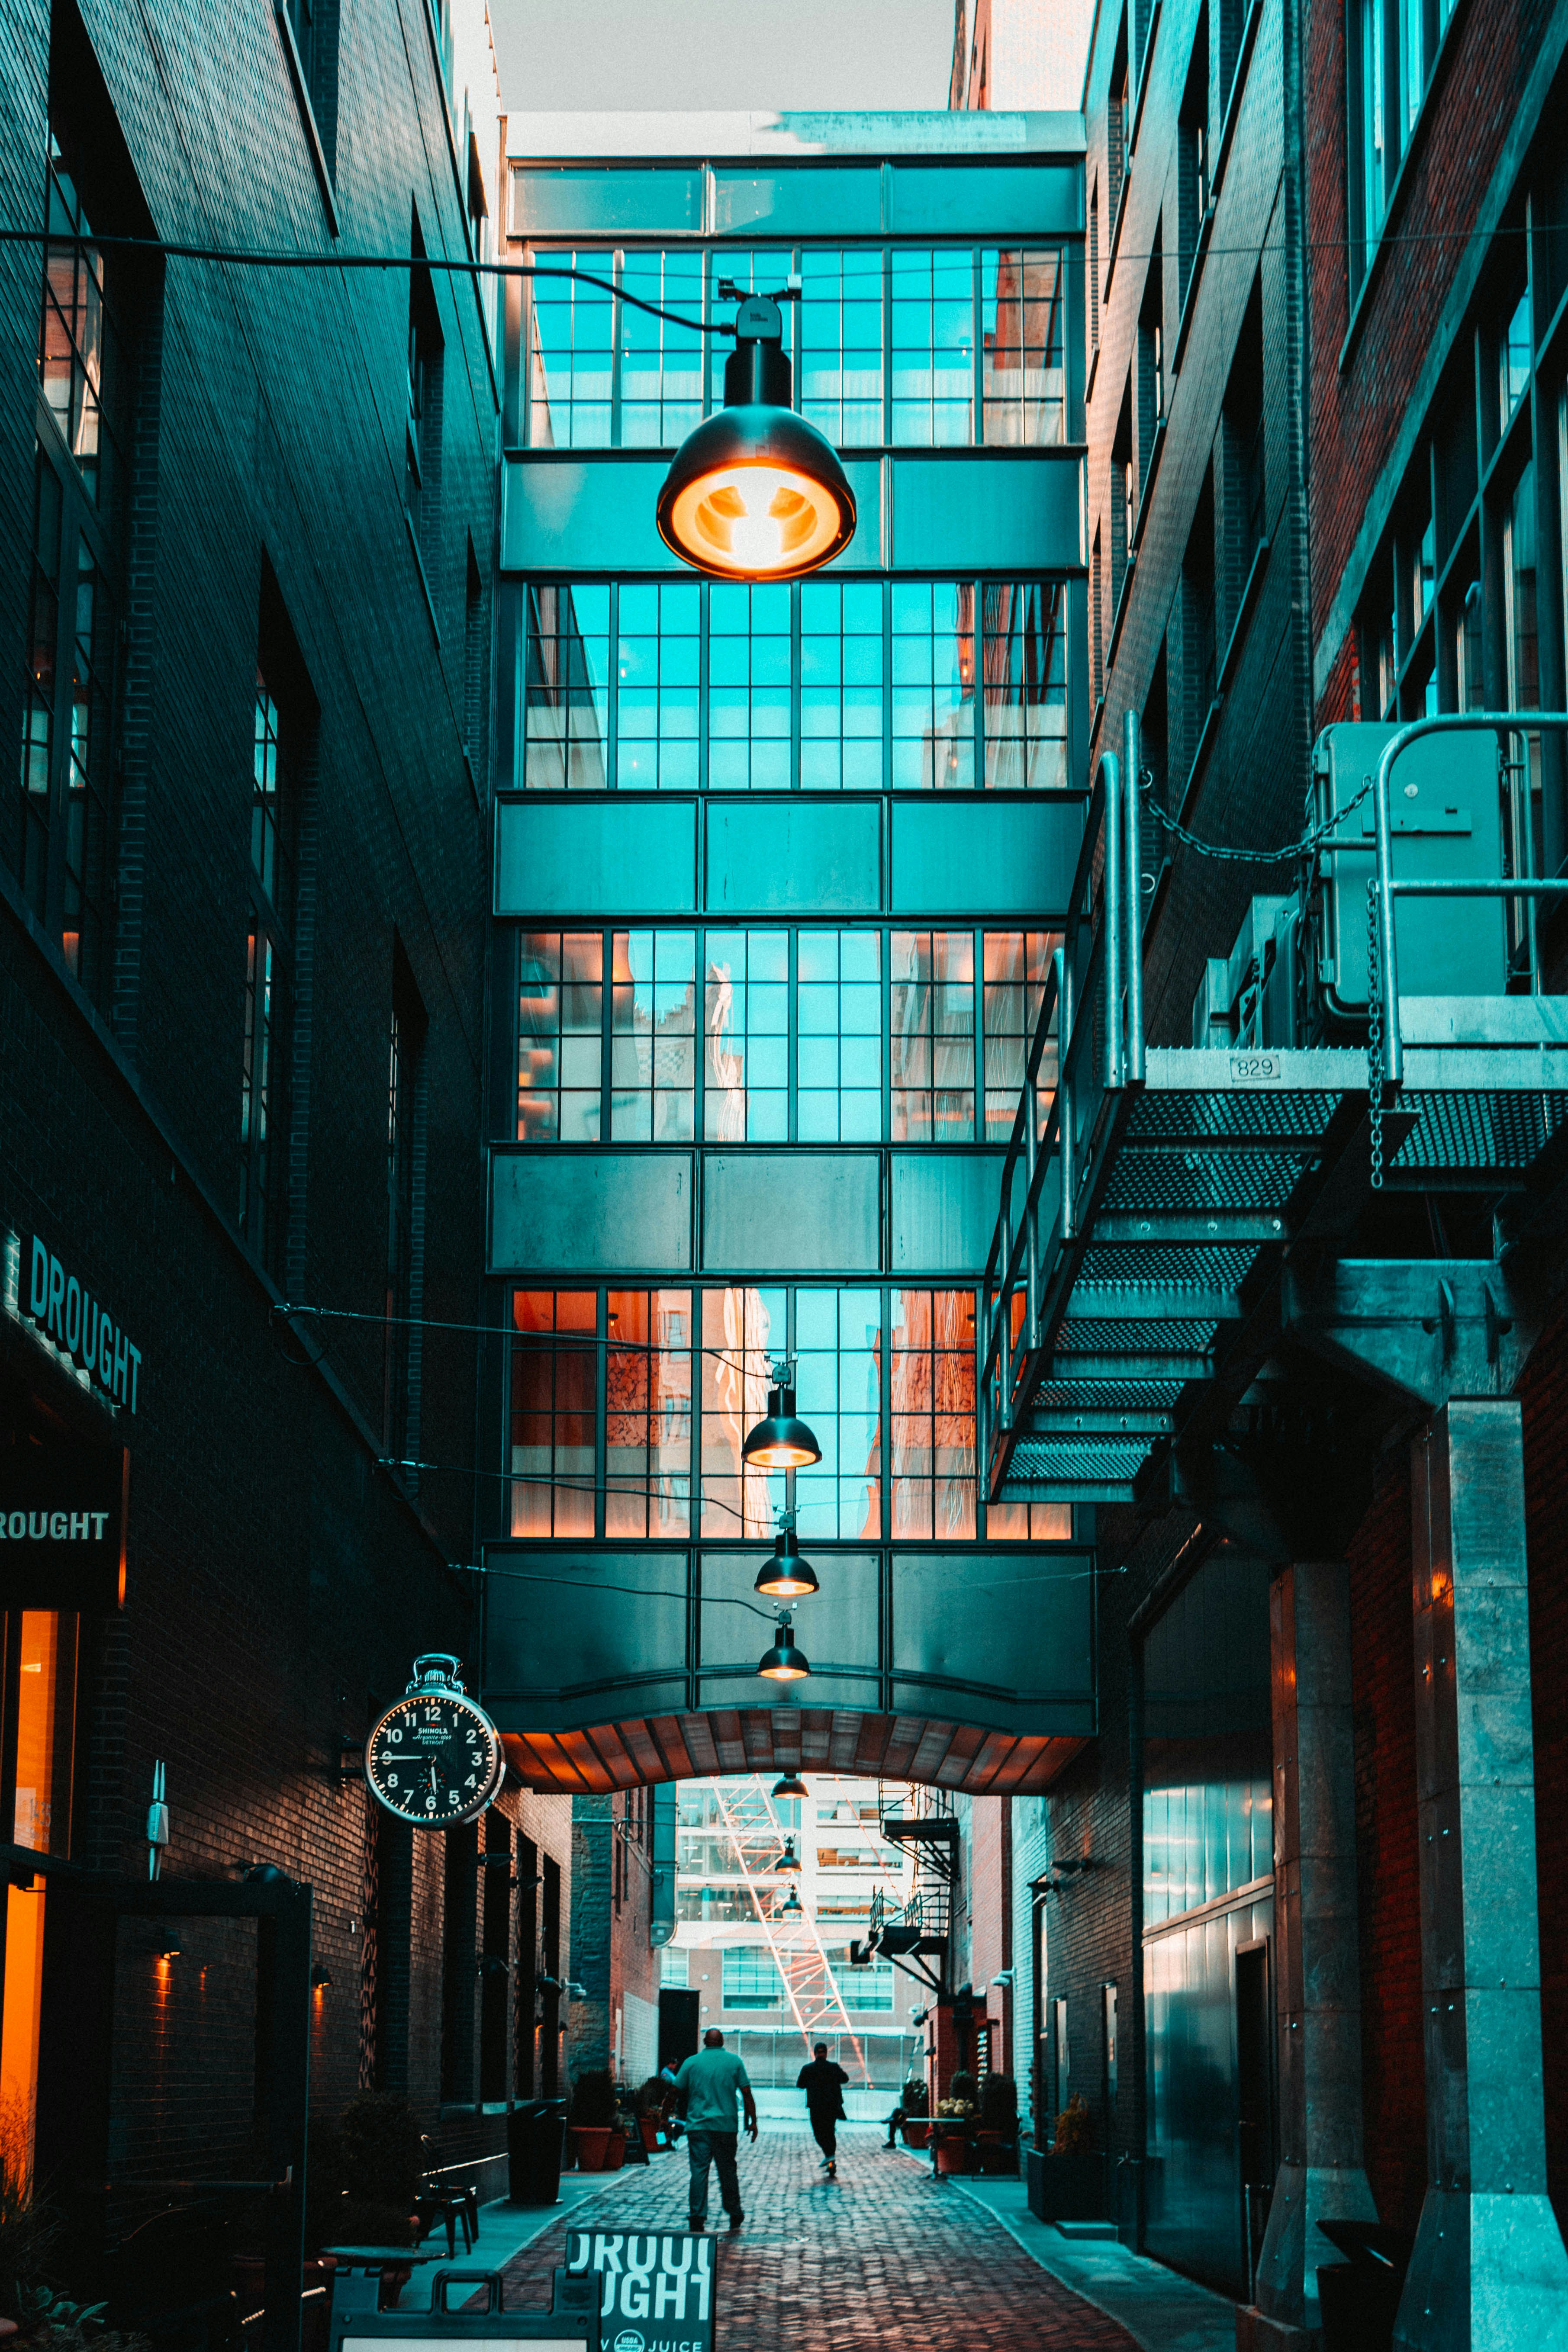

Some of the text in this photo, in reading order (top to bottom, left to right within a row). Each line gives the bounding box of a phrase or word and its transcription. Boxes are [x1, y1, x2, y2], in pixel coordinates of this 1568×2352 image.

[1238, 1059, 1273, 1077] 829
[30, 1234, 142, 1415] DROUGHT
[404, 1713, 416, 1727] 11
[425, 1707, 441, 1721] 12
[452, 1713, 458, 1727] 1
[386, 1729, 402, 1743] 10
[466, 1730, 476, 1744] 2
[382, 1751, 392, 1765] 9
[471, 1752, 482, 1766] 3
[387, 1773, 398, 1788] 8
[464, 1774, 476, 1788] 4
[404, 1790, 414, 1804] 7
[425, 1796, 436, 1810] 6
[449, 1790, 460, 1805] 5
[30, 1799, 51, 1827] 1435
[648, 2340, 702, 2352] JUICE
